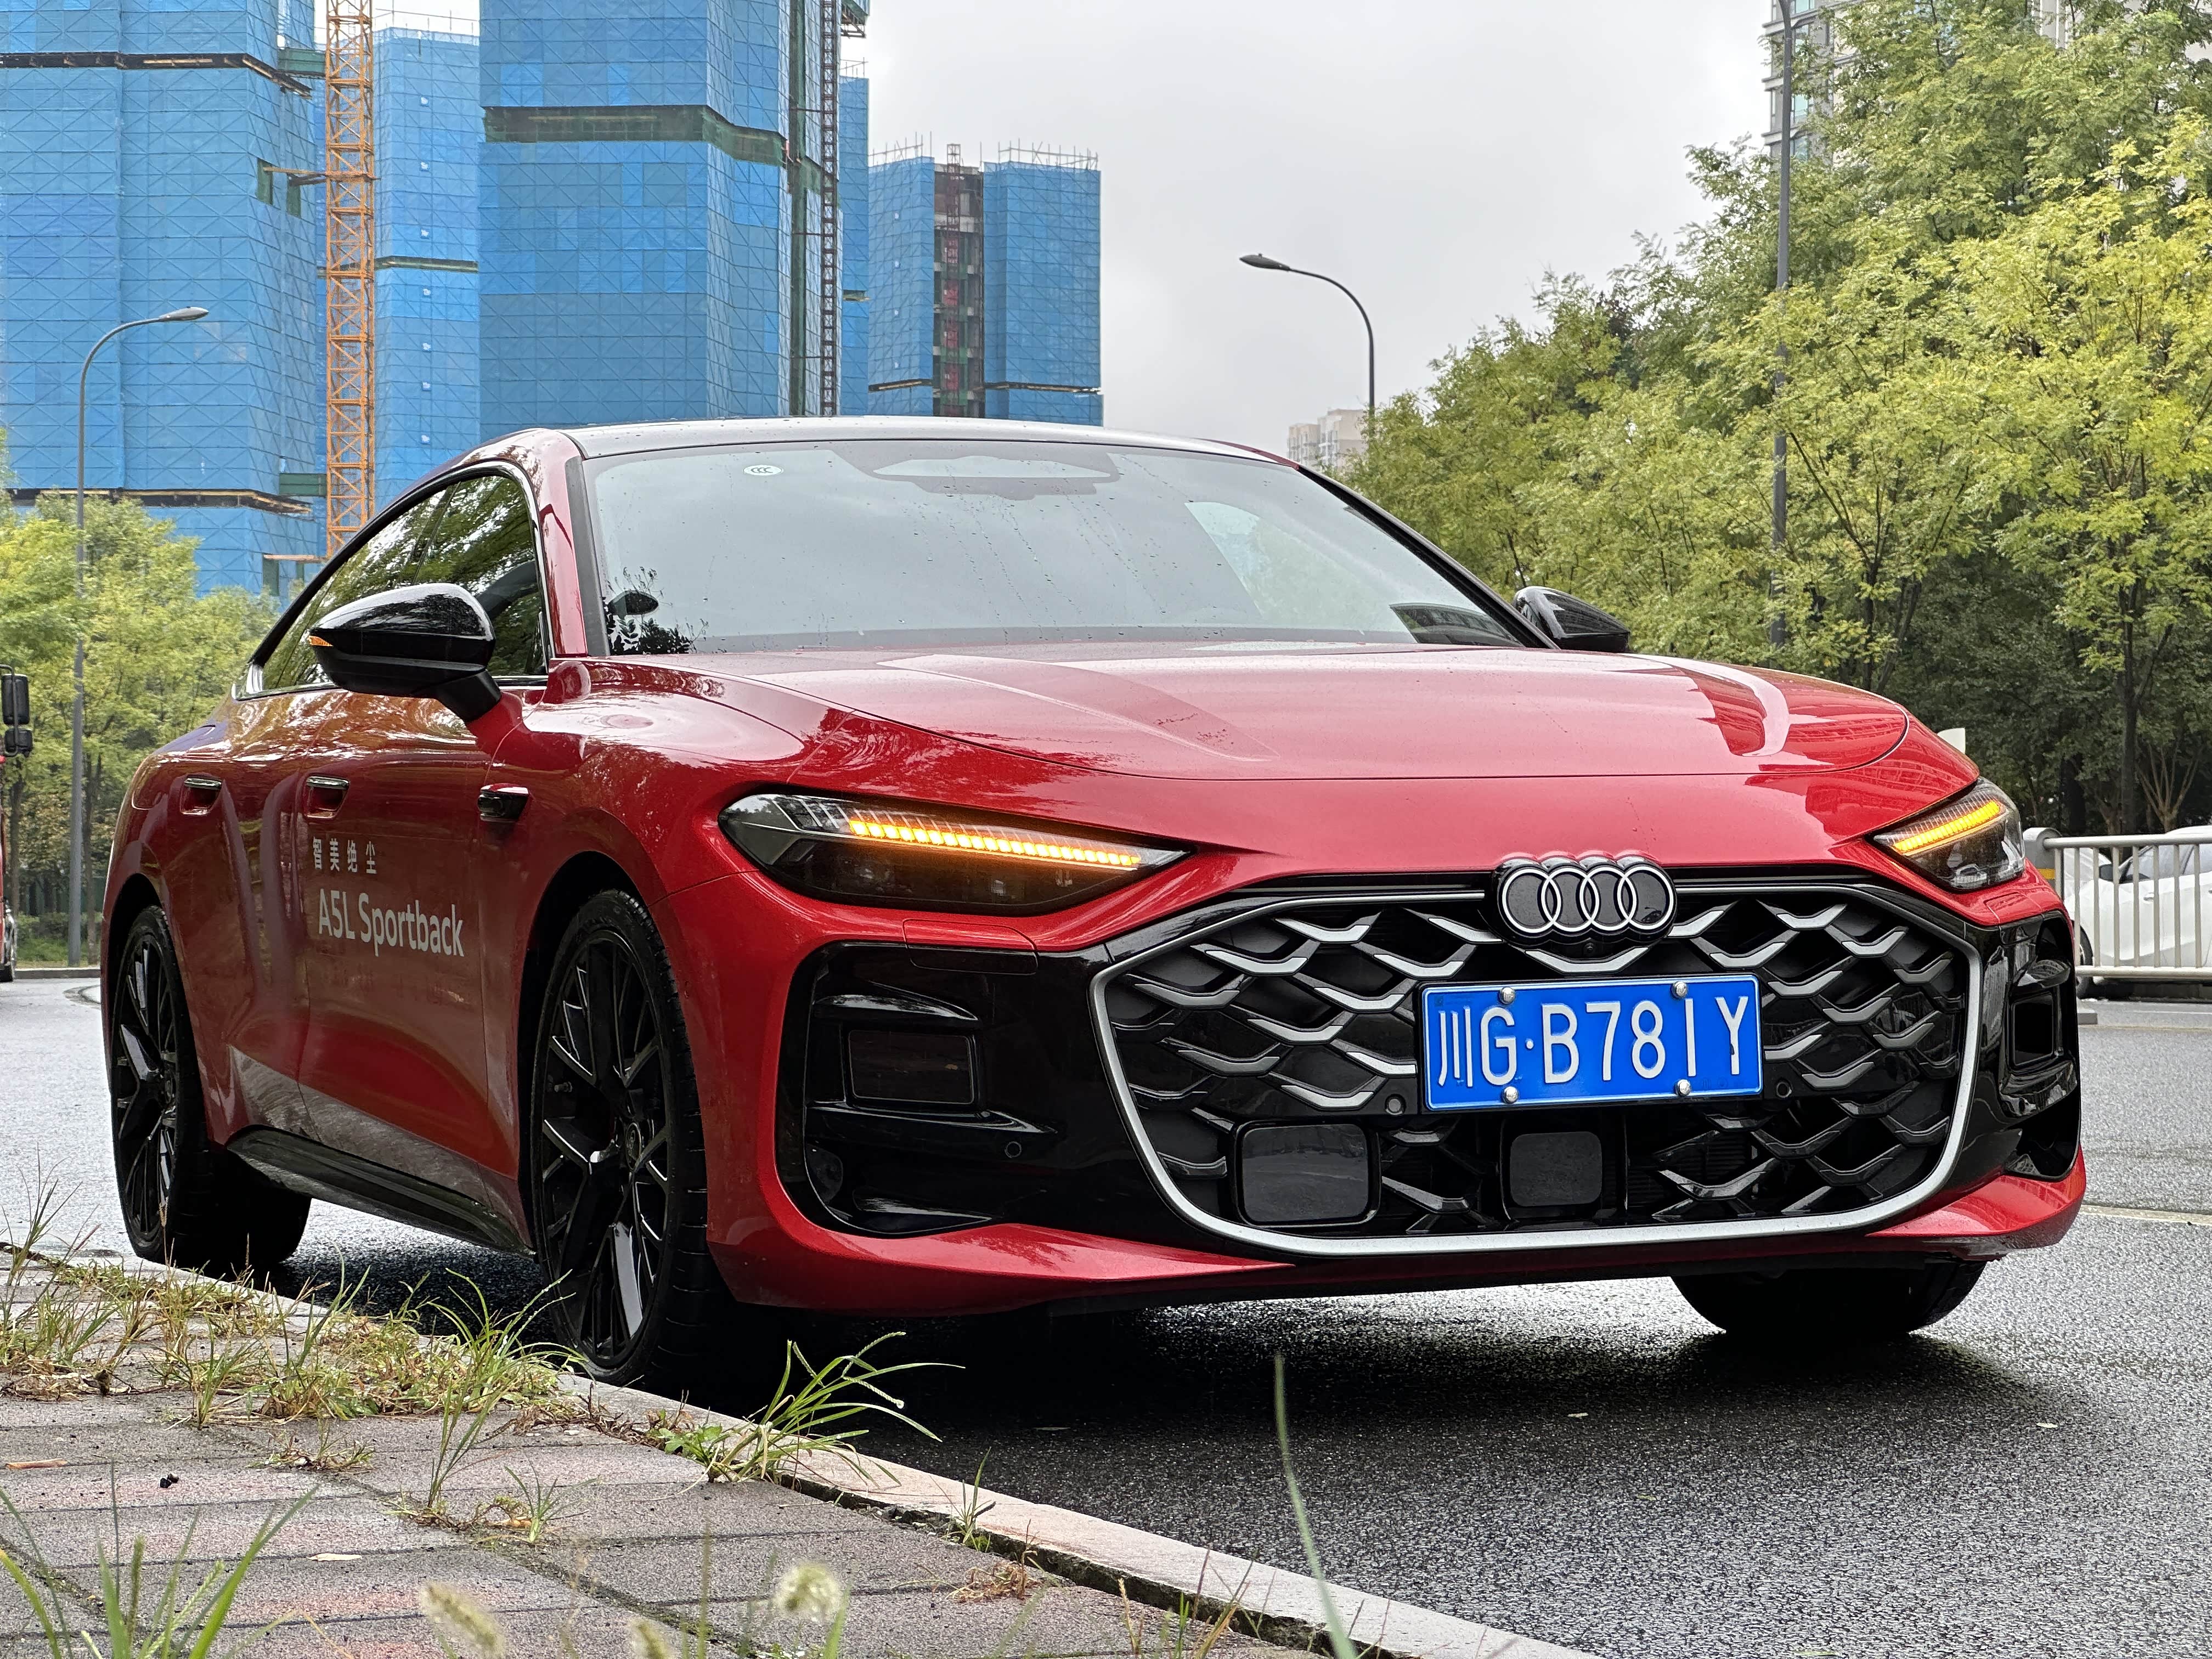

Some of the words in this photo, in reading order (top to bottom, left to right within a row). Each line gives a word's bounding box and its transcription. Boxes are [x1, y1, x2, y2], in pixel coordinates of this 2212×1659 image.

[313, 837, 377, 874] 智美绝尘
[318, 888, 356, 940] A5L
[358, 892, 465, 957] Sportback
